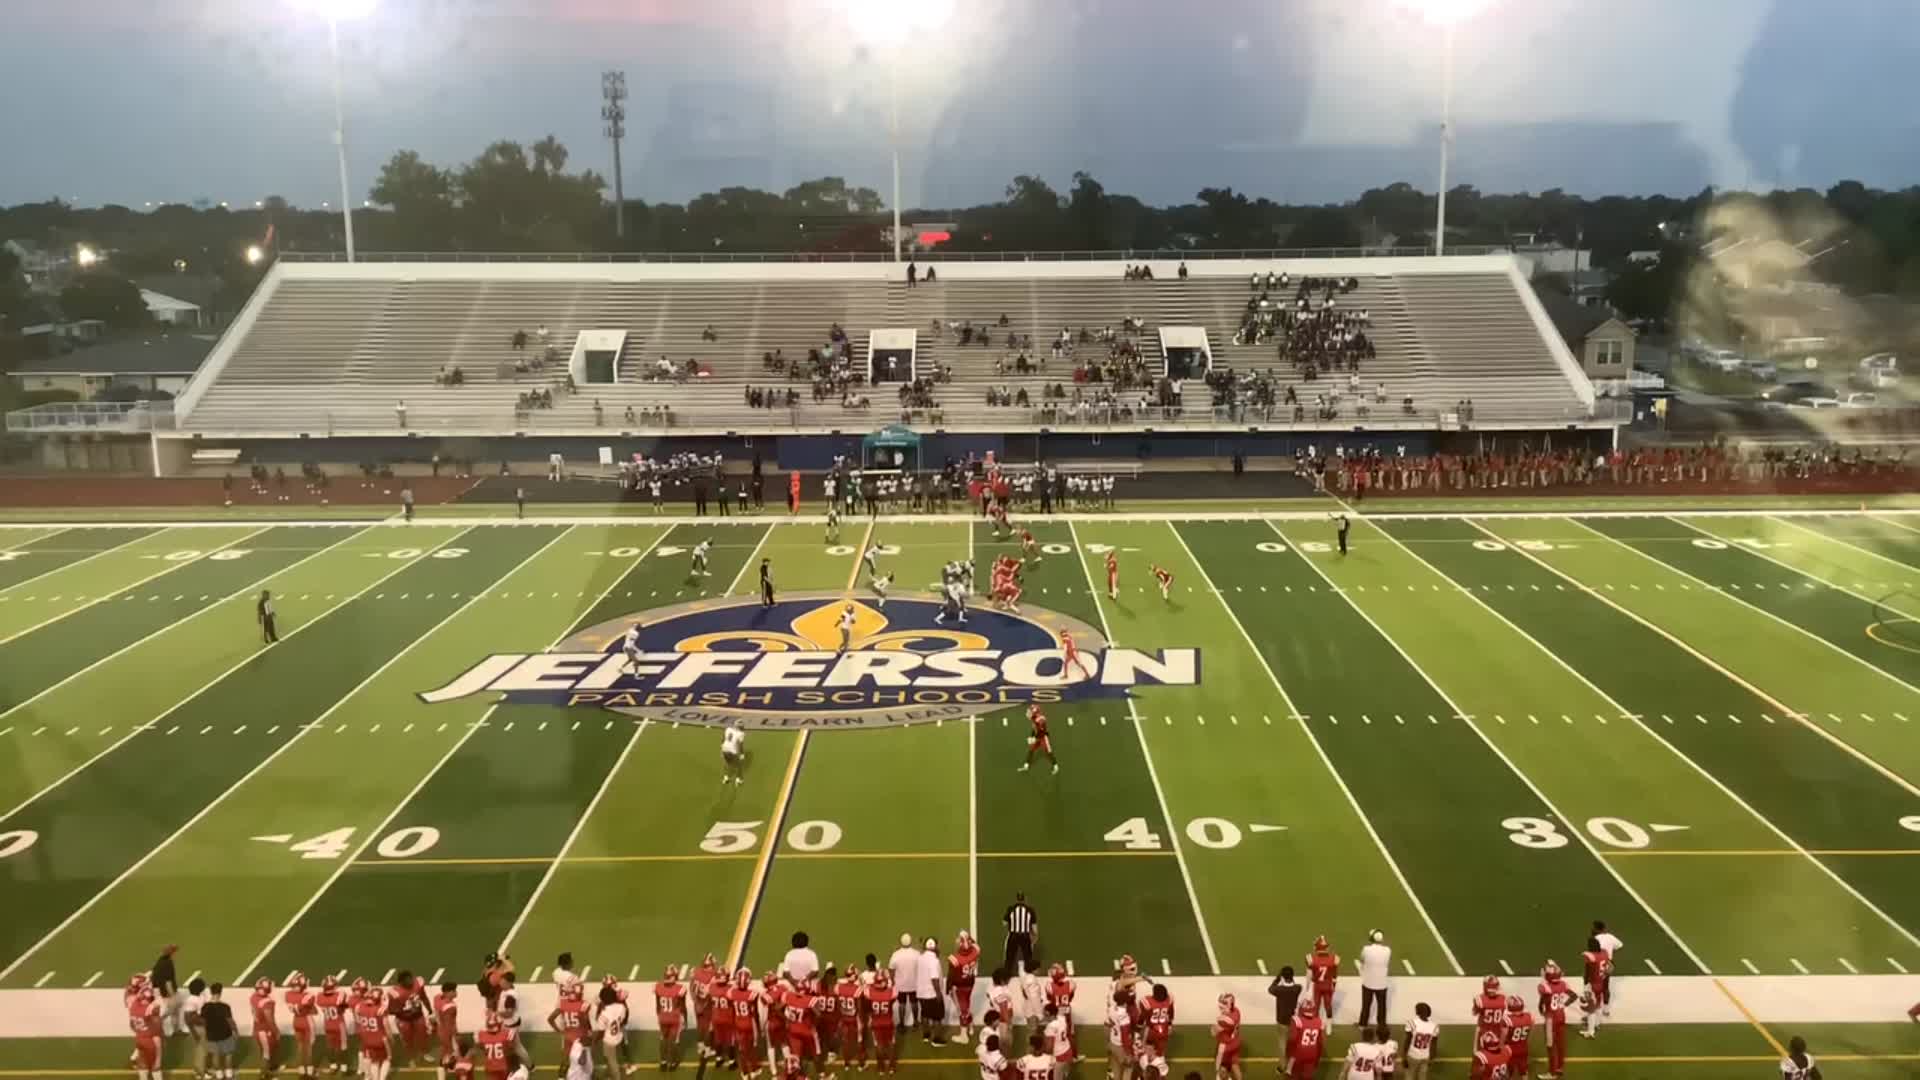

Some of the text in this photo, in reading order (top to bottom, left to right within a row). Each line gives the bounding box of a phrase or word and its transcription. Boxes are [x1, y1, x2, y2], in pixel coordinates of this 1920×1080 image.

[419, 648, 1198, 703] JEFFERSON
[568, 689, 1062, 706] PARISH SCHOOLS
[886, 705, 962, 723] LEAD
[733, 1001, 749, 1017] 18
[485, 1043, 504, 1059] 76
